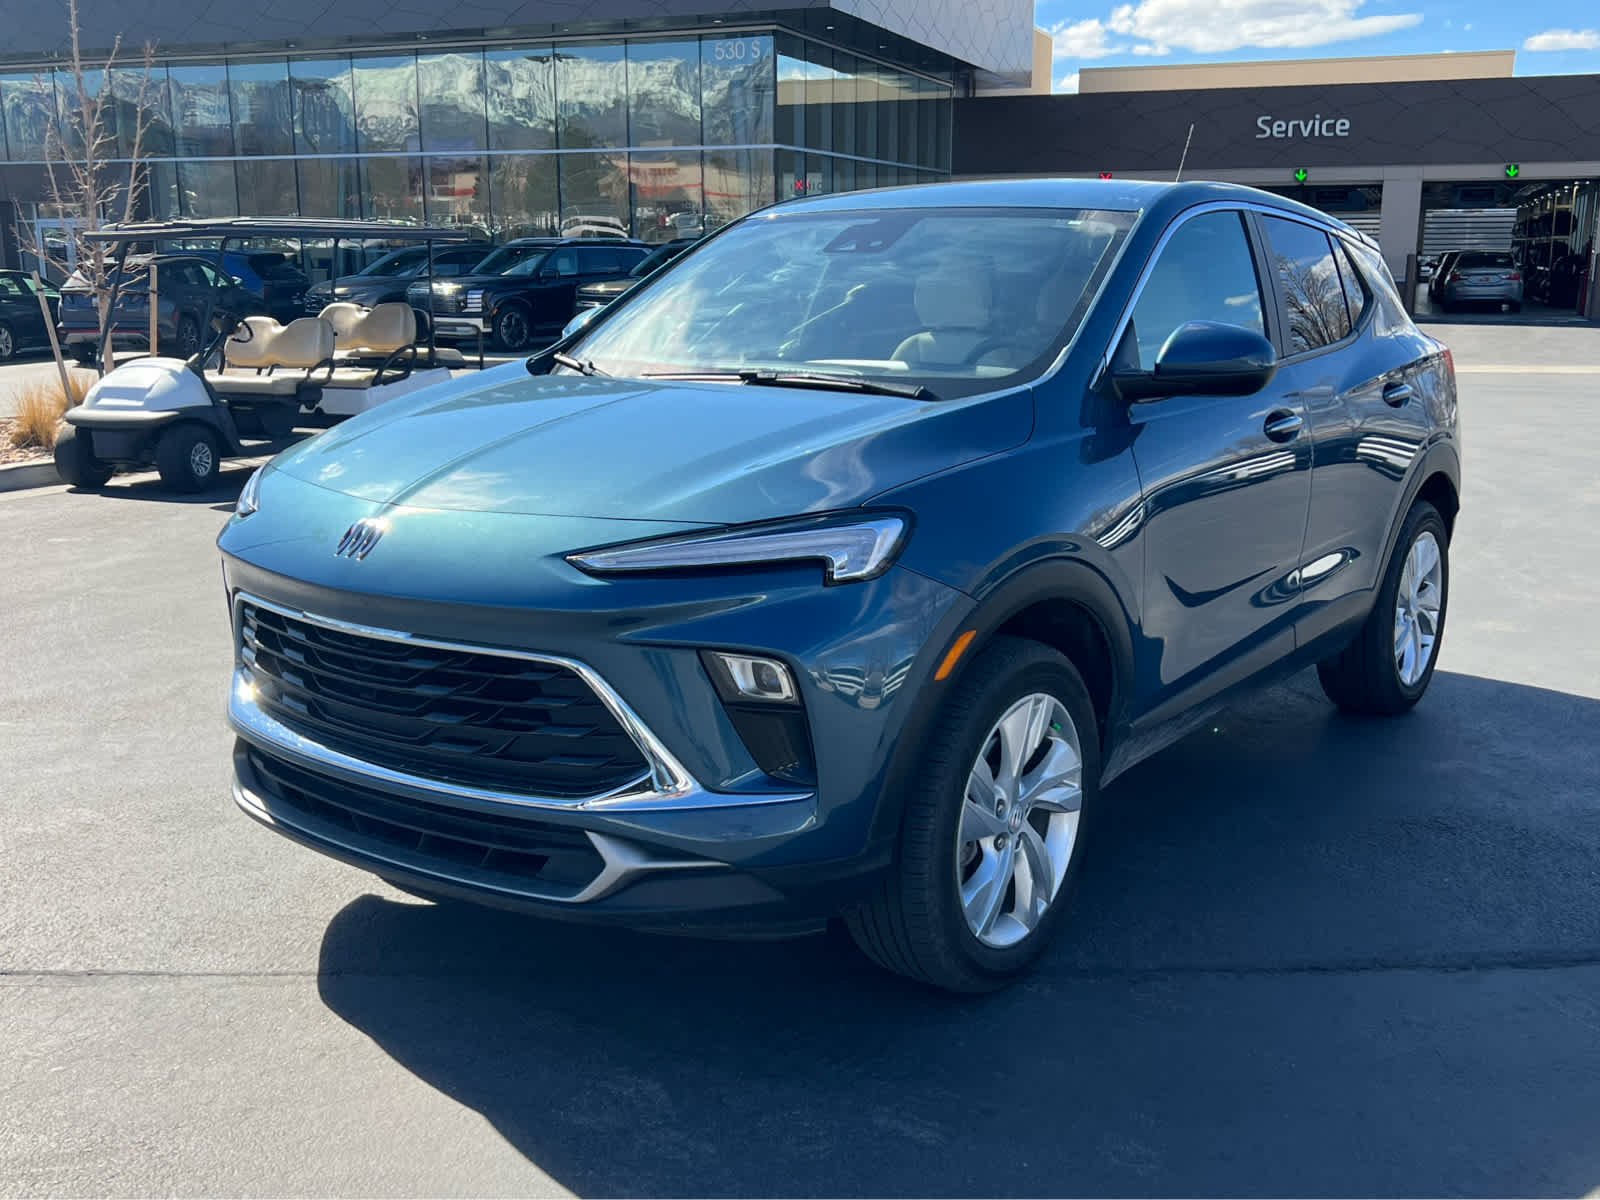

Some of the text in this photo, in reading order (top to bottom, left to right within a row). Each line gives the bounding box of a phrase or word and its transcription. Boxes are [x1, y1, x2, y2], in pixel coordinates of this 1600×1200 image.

[714, 40, 761, 60] 530 S
[1255, 114, 1351, 139] Service
